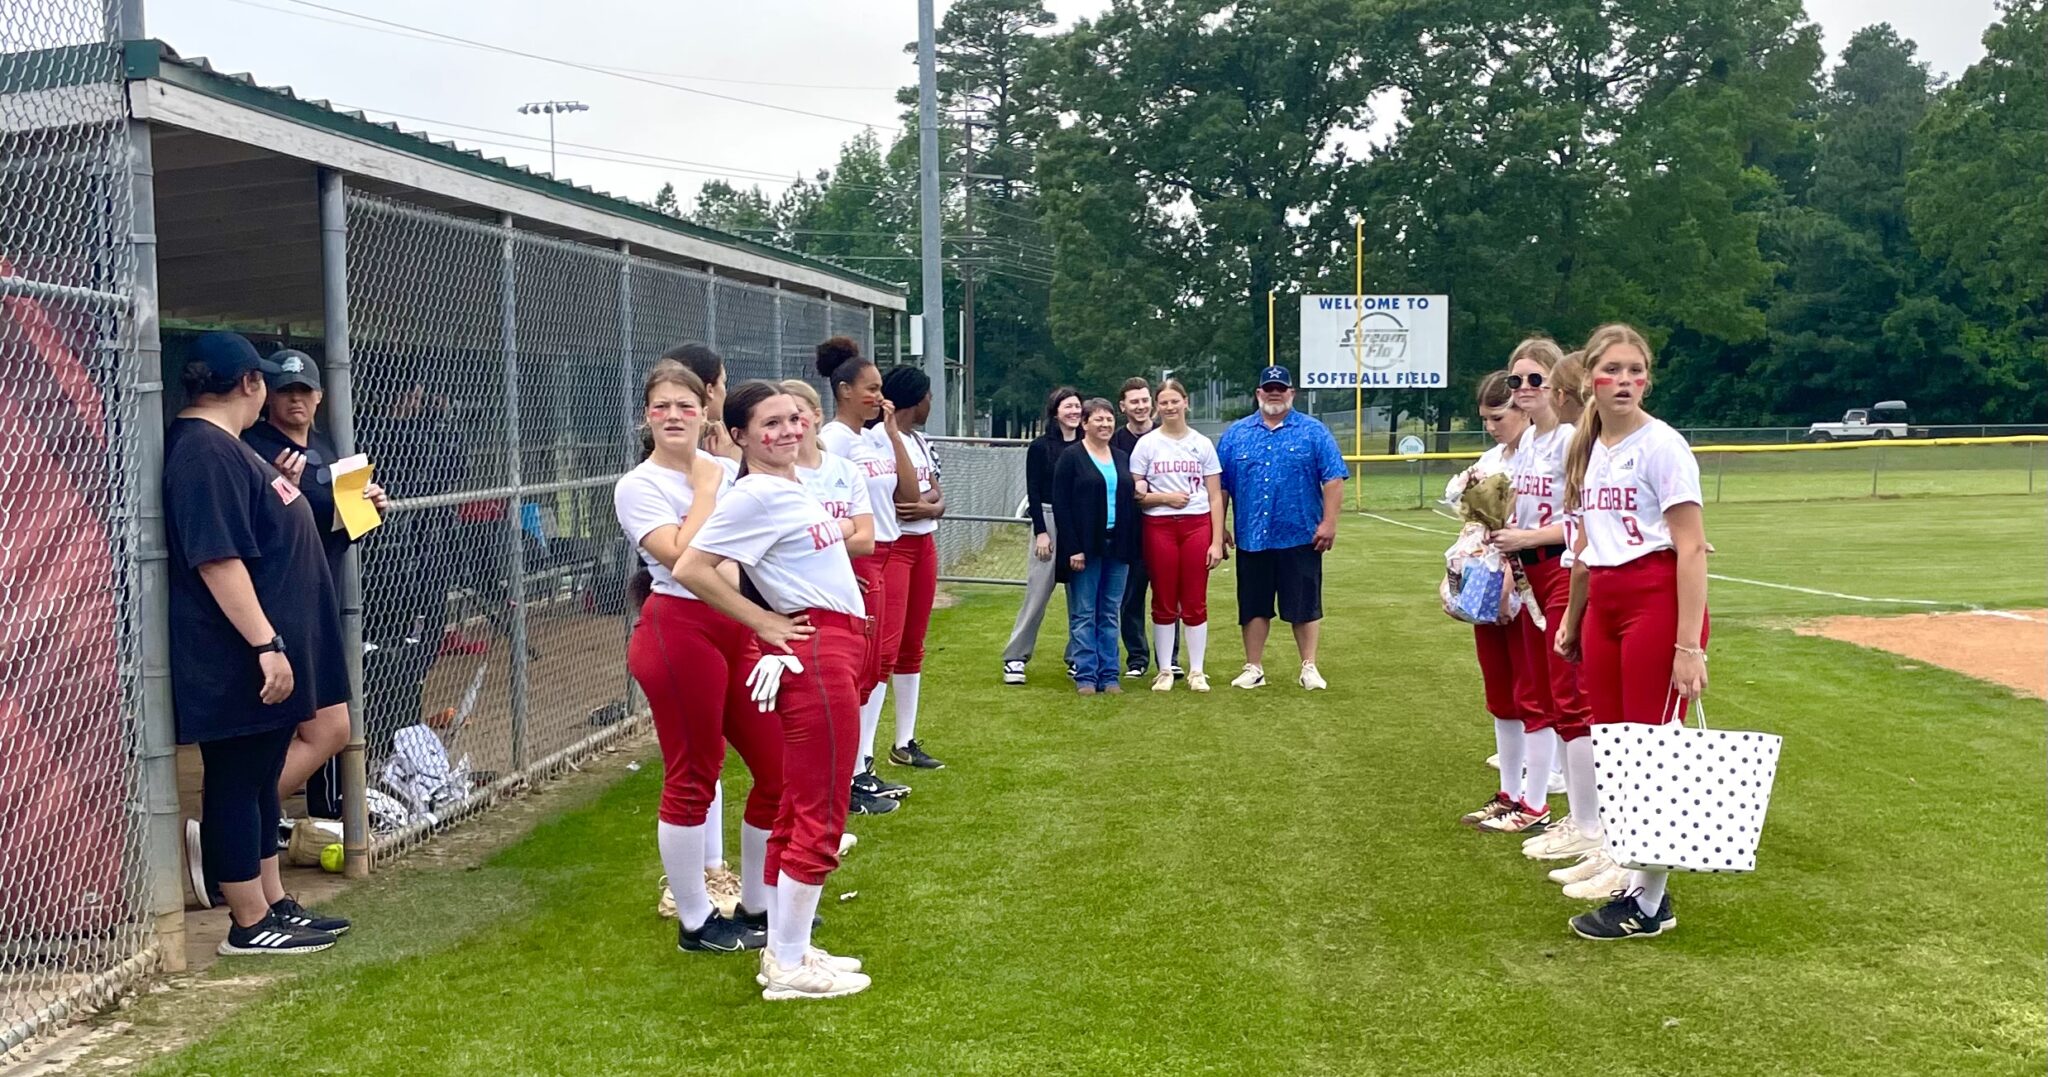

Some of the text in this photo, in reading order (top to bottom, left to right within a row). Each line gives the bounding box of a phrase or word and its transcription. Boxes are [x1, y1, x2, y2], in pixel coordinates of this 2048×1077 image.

[1319, 297, 1429, 310] WELCOME TO
[1307, 372, 1441, 385] SOFTBALL FIELD
[1153, 460, 1201, 475] KILGORE
[1187, 476, 1200, 494] 17
[1537, 502, 1552, 529] 2
[1621, 516, 1643, 546] 9
